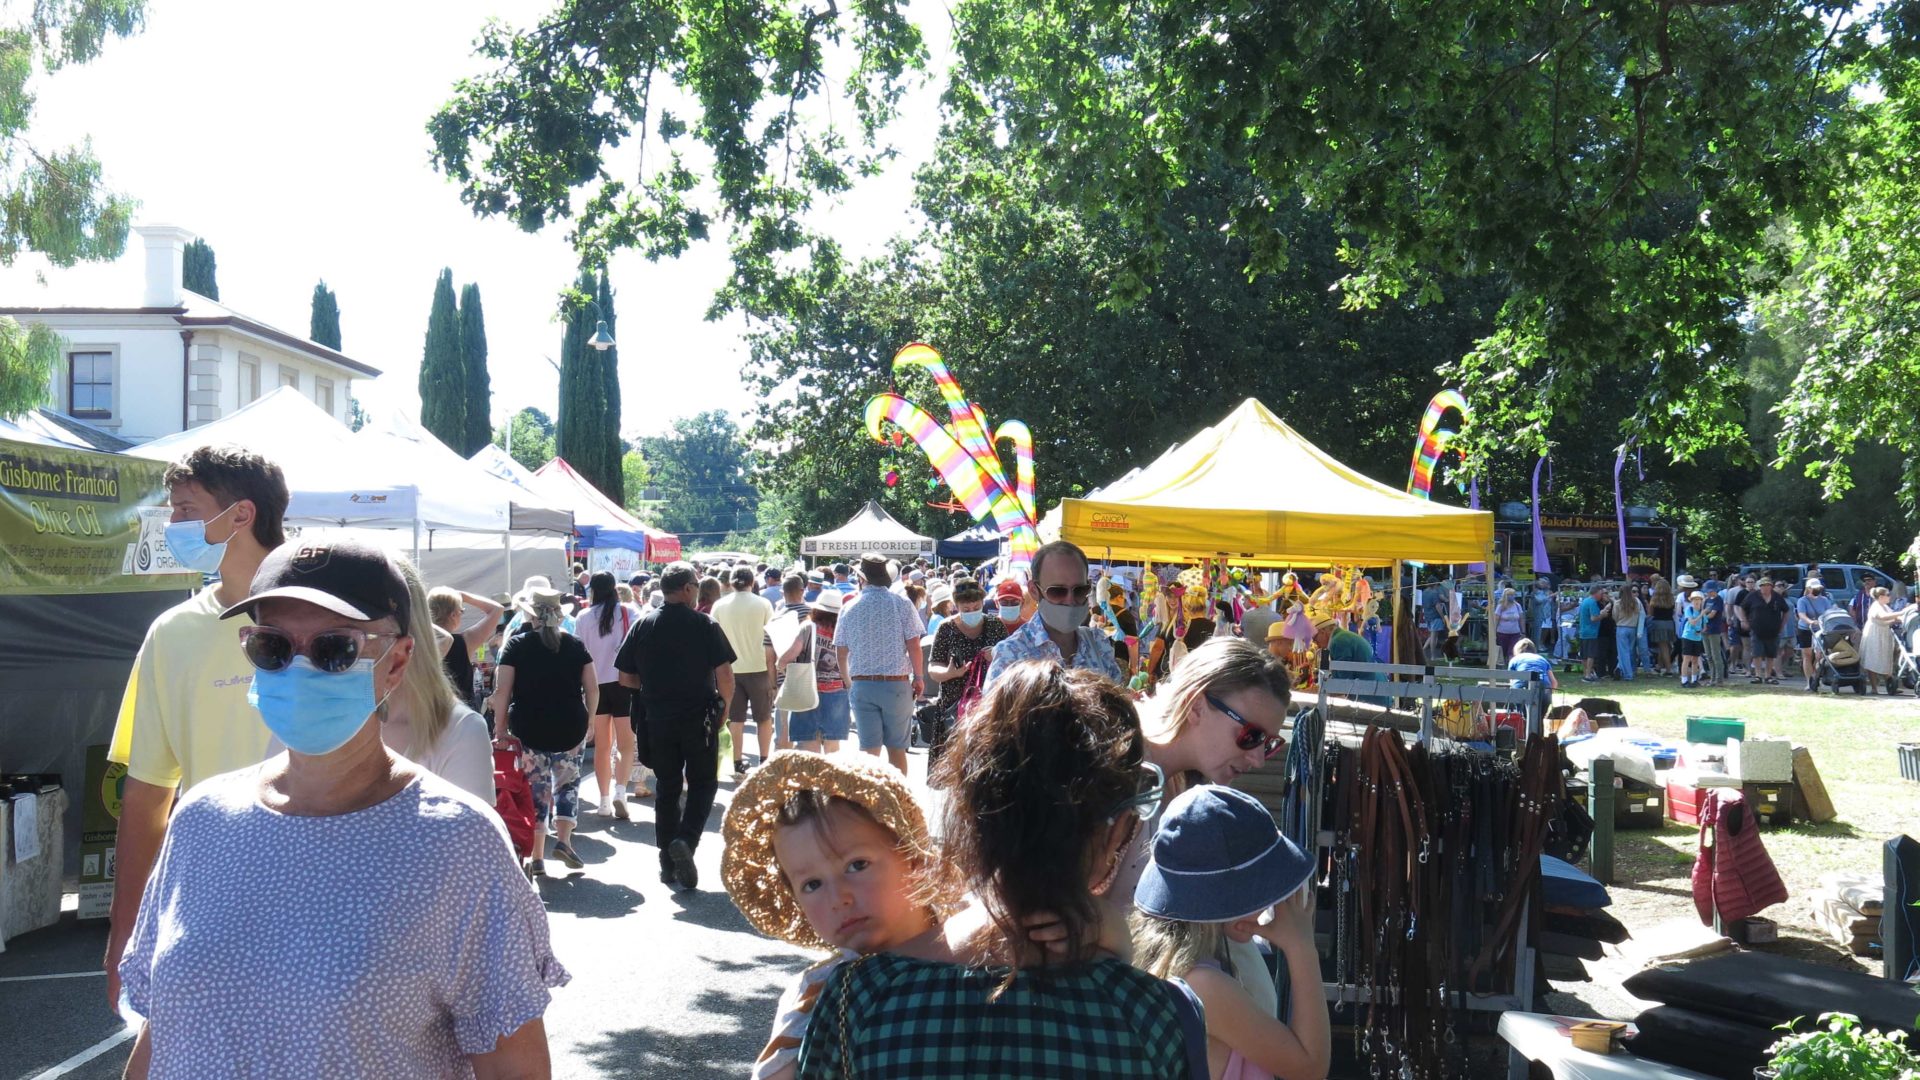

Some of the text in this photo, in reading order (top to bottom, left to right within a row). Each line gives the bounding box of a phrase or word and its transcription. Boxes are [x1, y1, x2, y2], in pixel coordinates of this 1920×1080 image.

[0, 461, 118, 497] Gisborne Frantoio
[31, 501, 104, 536] Olive Oil
[1540, 516, 1619, 528] Baked Potatoe
[822, 541, 917, 551] FRESH LICORICE
